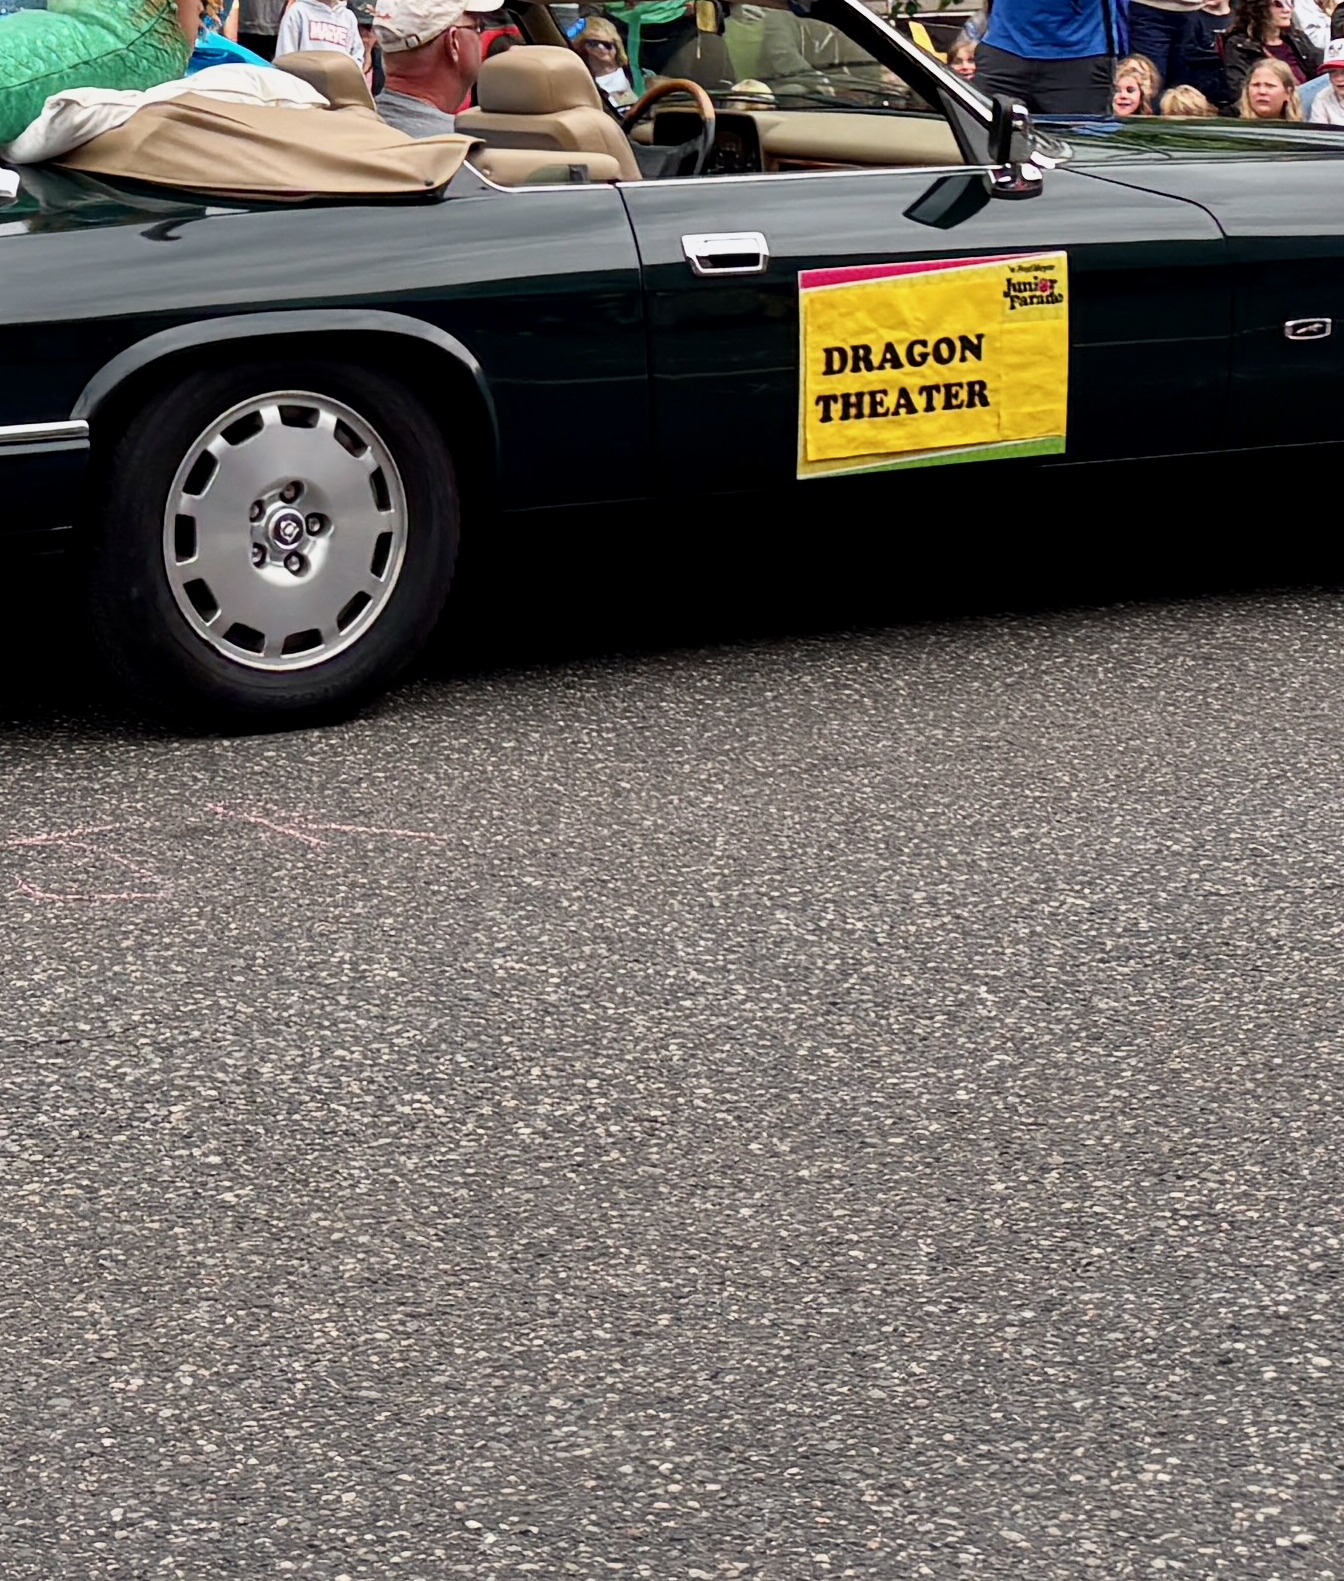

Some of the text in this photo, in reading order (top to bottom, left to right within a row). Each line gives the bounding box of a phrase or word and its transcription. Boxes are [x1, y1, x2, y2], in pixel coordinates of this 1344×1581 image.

[1003, 276, 1057, 298] Junior
[1009, 291, 1063, 310] Parade
[822, 333, 985, 375] DRAGON
[815, 380, 990, 423] THEATER
